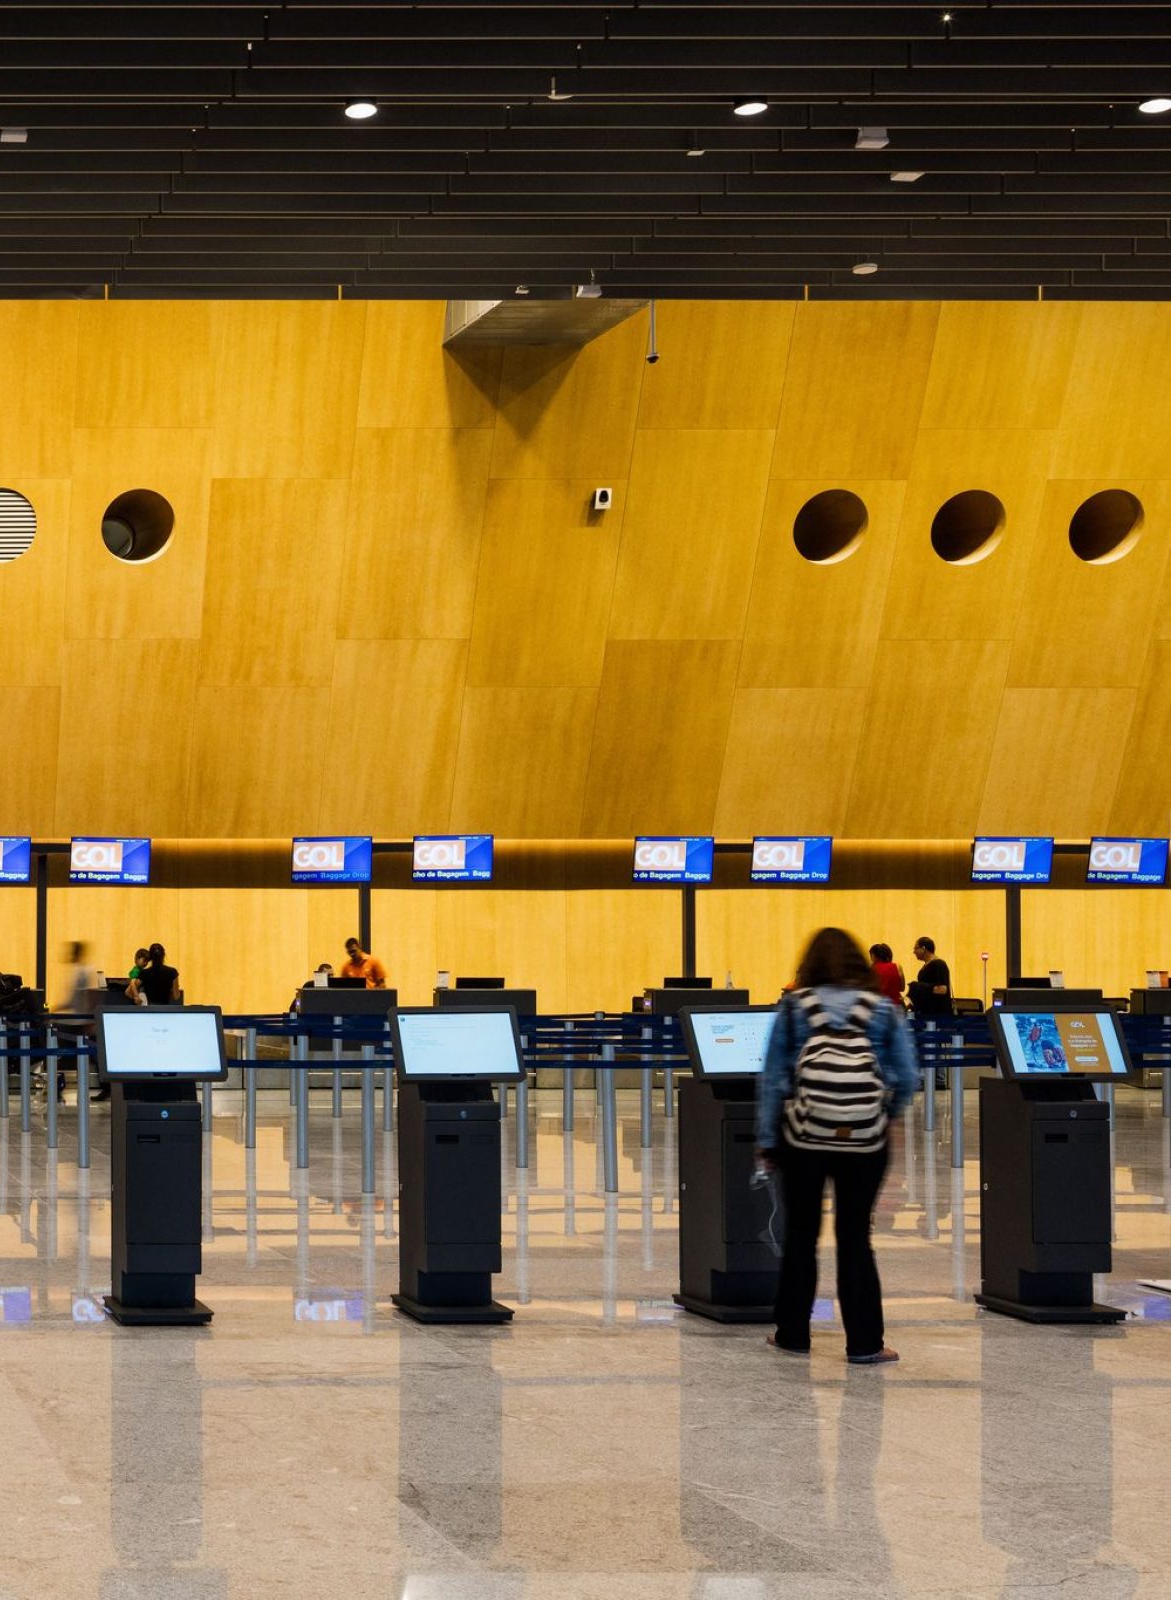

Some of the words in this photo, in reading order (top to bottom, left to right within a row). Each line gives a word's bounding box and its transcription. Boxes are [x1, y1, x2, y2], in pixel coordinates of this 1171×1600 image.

[72, 846, 121, 868] GOL
[293, 846, 344, 868] GOL
[415, 845, 465, 866] GOL
[636, 845, 686, 867] GOL
[754, 845, 803, 867] GOL
[975, 845, 1025, 867] GOL
[1091, 846, 1139, 868] GOL
[437, 871, 469, 879] Bagagem
[649, 872, 681, 880] Bagagem
[780, 872, 810, 880] Baggage
[1005, 872, 1035, 880] Baggage
[1097, 872, 1129, 880] Bagagem
[1132, 873, 1161, 881] Baggage
